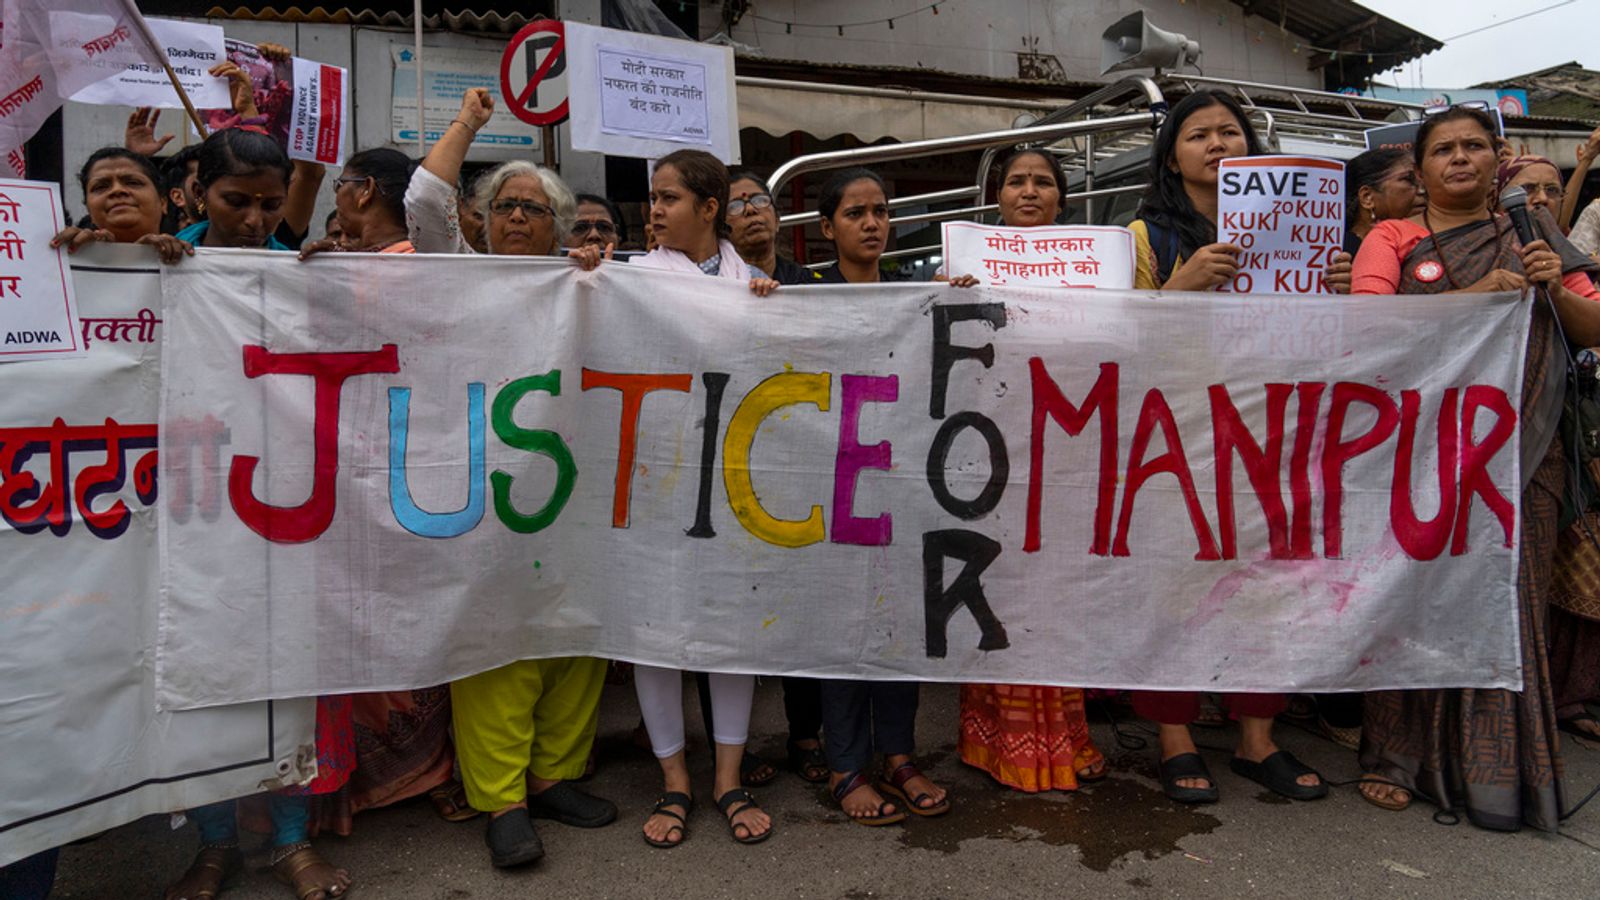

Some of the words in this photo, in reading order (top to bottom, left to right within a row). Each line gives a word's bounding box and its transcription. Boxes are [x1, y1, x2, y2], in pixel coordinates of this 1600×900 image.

[621, 58, 647, 76] मोदी
[649, 66, 685, 80] सरकार
[603, 77, 638, 92] नफरत
[641, 80, 656, 95] की
[660, 84, 703, 100] राजनीति
[298, 87, 307, 125] VIOLENCE
[629, 97, 647, 112] बंद
[649, 99, 671, 114] करो
[295, 128, 304, 151] STOP
[306, 116, 317, 152] AGAINST
[1222, 171, 1308, 197] SAVE
[1318, 178, 1339, 195] ZO
[1272, 201, 1293, 214] ZO
[1295, 200, 1342, 220] KUKI
[1223, 212, 1278, 231] KUKI
[1291, 224, 1340, 244] KUKI
[984, 232, 1027, 255] मोदी
[1032, 237, 1095, 253] सरकार
[983, 257, 1068, 279] गुनाहगारो
[1072, 256, 1101, 276] को
[1234, 251, 1269, 270] UKI
[1273, 249, 1302, 261] KUKI
[5, 331, 62, 345] AIDWA
[229, 343, 898, 548] JUSTICE
[1022, 356, 1518, 561] MANIPUR
[924, 302, 1009, 658] FOR
